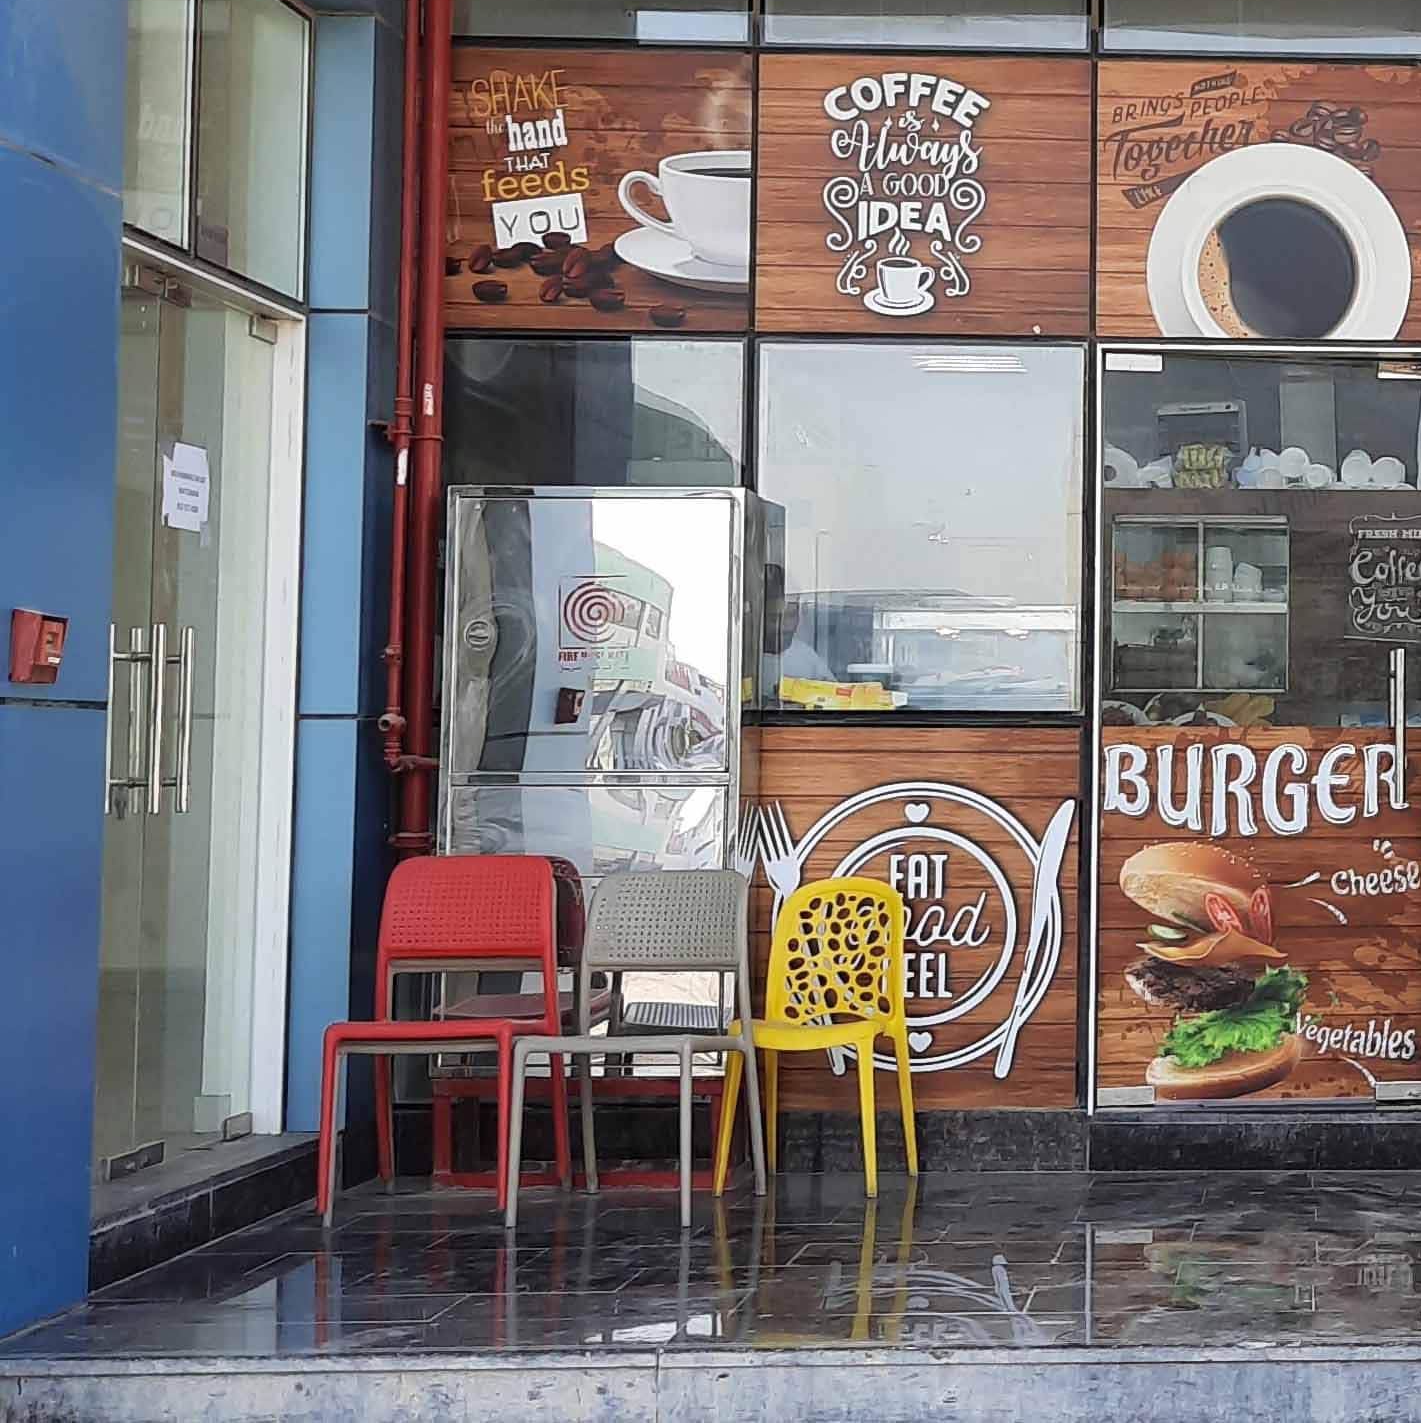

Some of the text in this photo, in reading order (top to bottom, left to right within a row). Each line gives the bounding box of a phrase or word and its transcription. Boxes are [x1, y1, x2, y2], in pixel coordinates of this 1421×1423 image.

[471, 69, 569, 118] SHAKE
[823, 72, 992, 128] COFFEE
[1112, 86, 1265, 124] BRINGS PEOPLE
[505, 108, 568, 153] hand
[831, 119, 984, 180] Always
[481, 160, 591, 202] feeds
[503, 152, 551, 174] THAT
[860, 172, 950, 197] A GOOD
[500, 207, 580, 237] YOU
[857, 200, 952, 242] IDEA
[1102, 743, 1410, 837] BURGER
[889, 854, 948, 899] EAT
[882, 952, 953, 998] EEL
